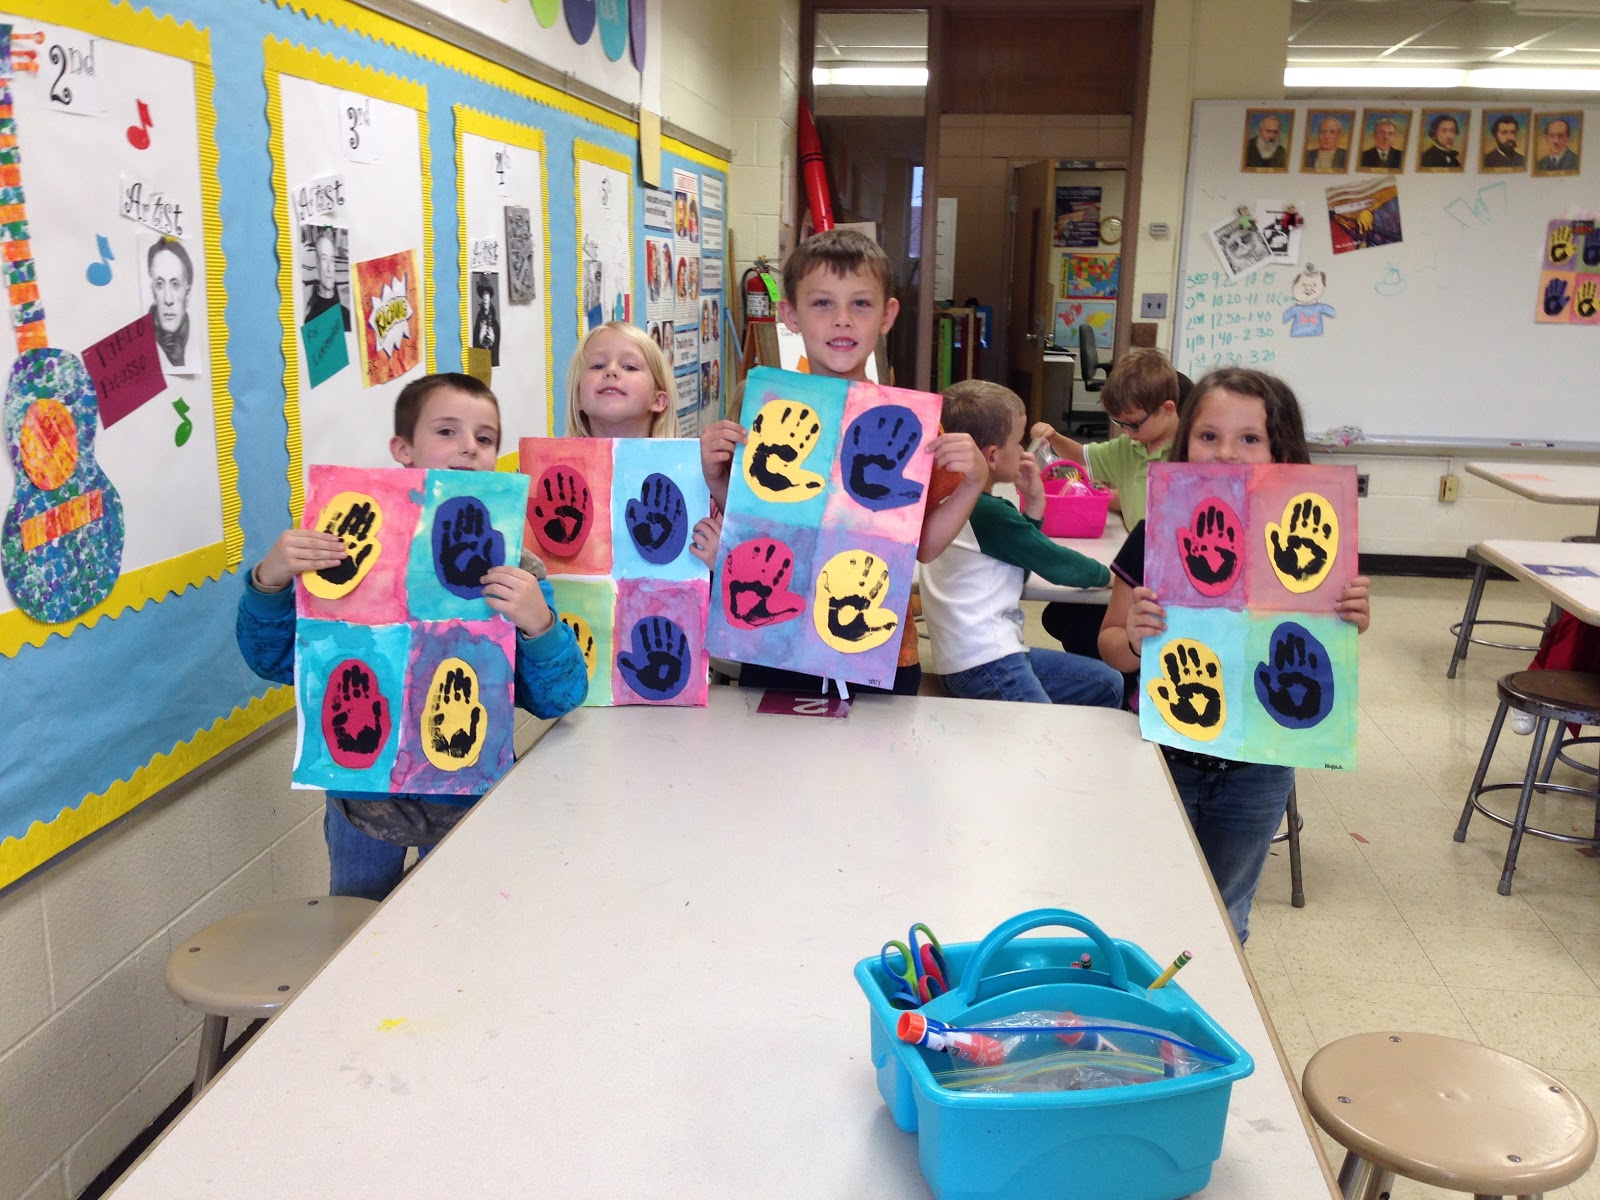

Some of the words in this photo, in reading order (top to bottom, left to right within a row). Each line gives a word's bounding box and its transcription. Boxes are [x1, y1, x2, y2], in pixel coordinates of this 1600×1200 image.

[49, 39, 96, 106] 2nd
[347, 99, 370, 150] 3rd
[124, 182, 184, 236] Artist
[298, 180, 345, 221] Artist
